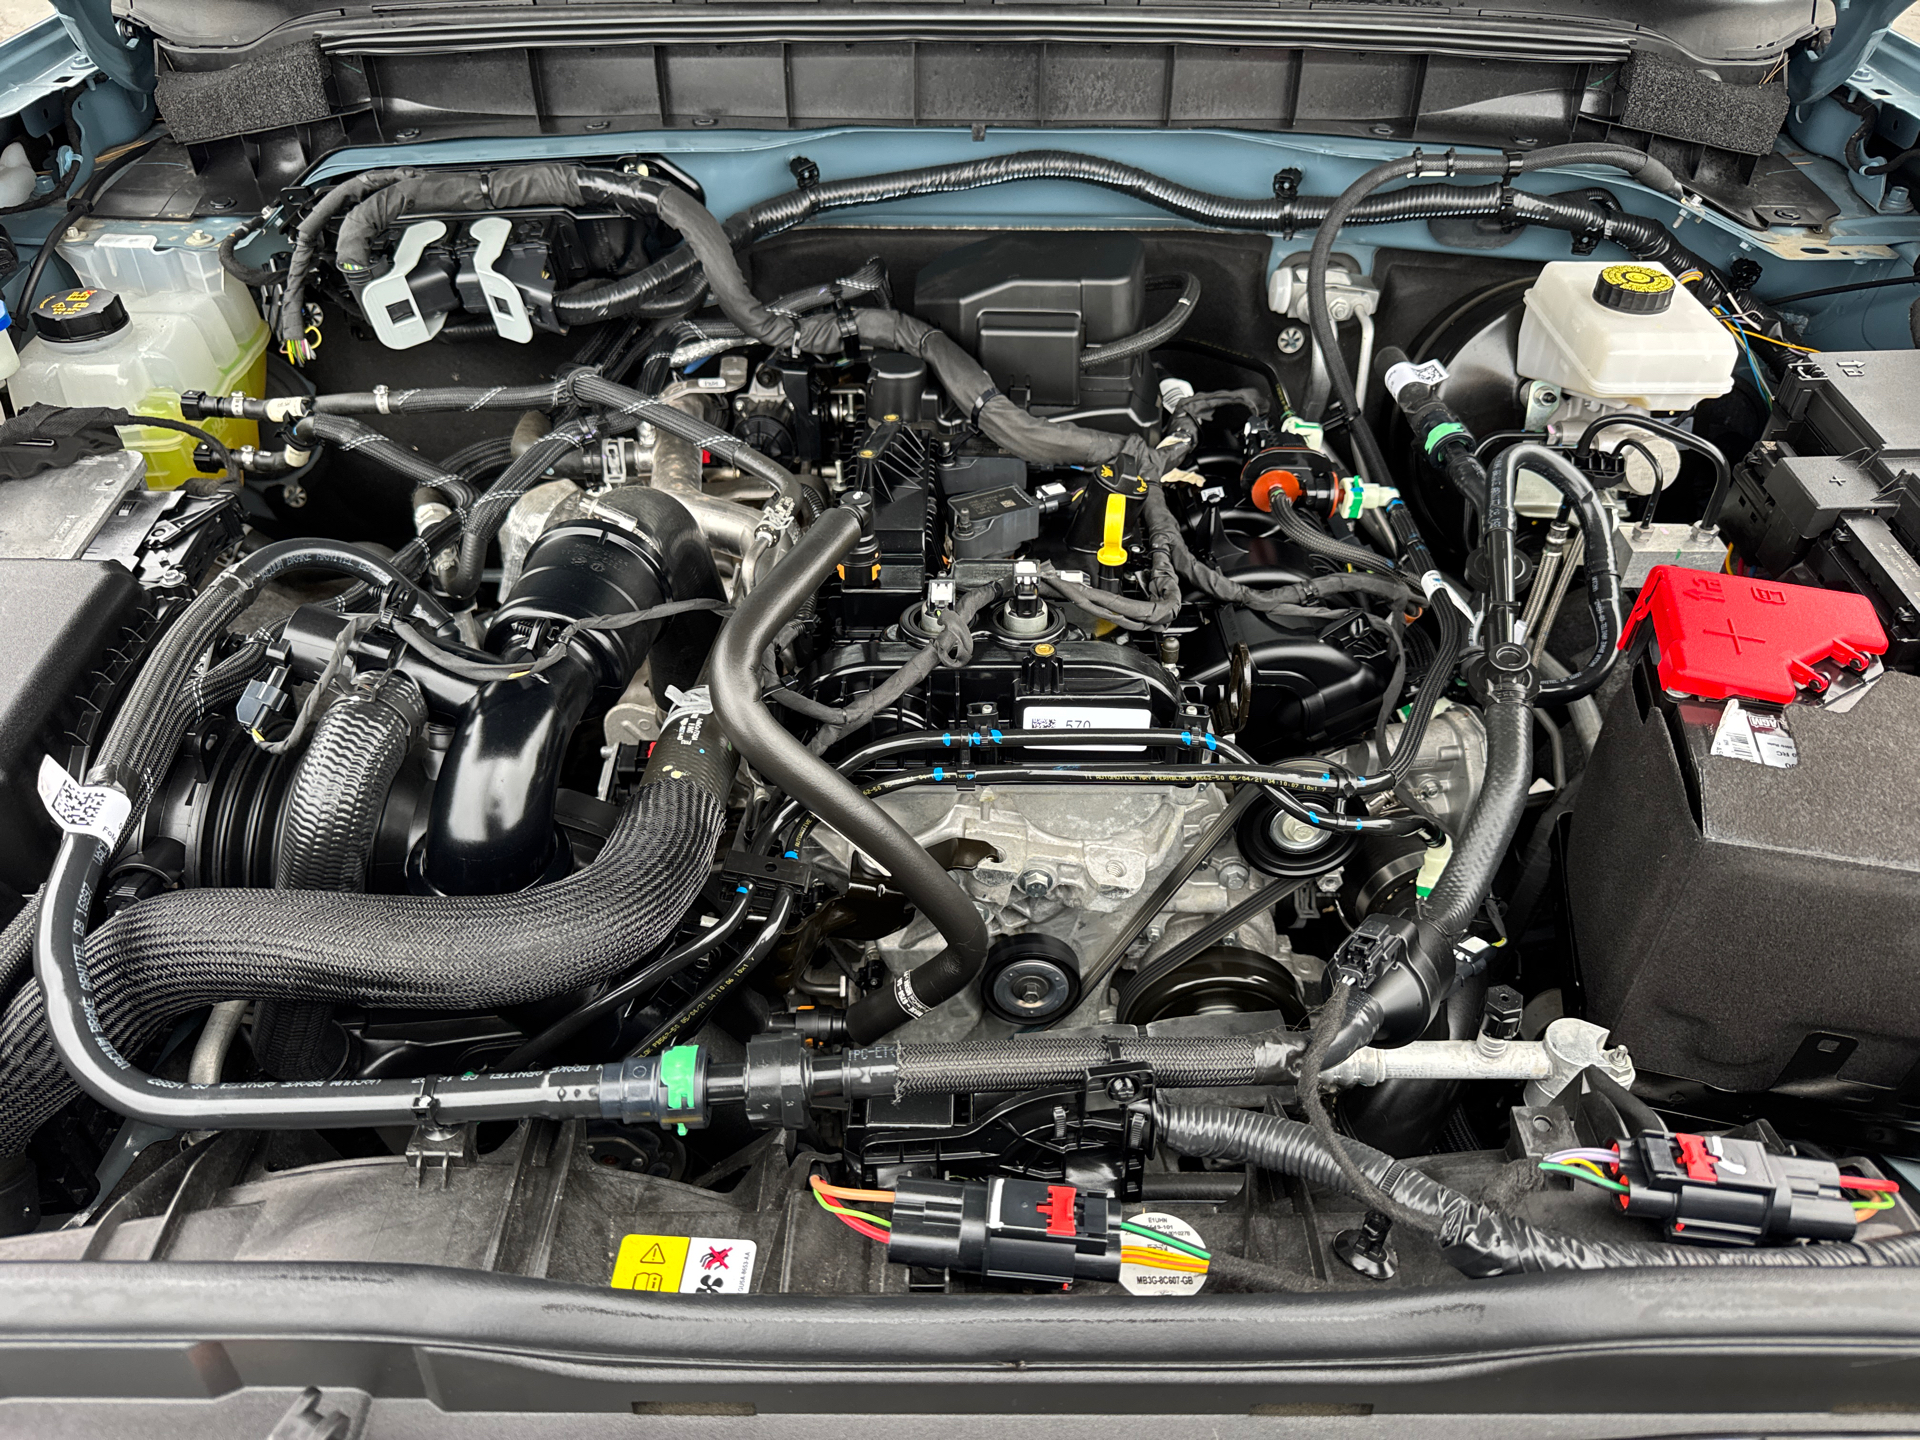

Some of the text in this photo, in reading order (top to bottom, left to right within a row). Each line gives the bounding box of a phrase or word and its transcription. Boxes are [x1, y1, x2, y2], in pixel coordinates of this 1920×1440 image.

[287, 554, 312, 566] BRAKE
[1752, 716, 1777, 728] AGM
[75, 881, 93, 917] 16897
[72, 917, 85, 937] CB
[73, 943, 94, 992] ARNITEL
[82, 996, 103, 1034] BRAKE
[680, 1001, 707, 1024] 05/04/21
[1137, 1276, 1194, 1285] MB3G-8C607-GB
